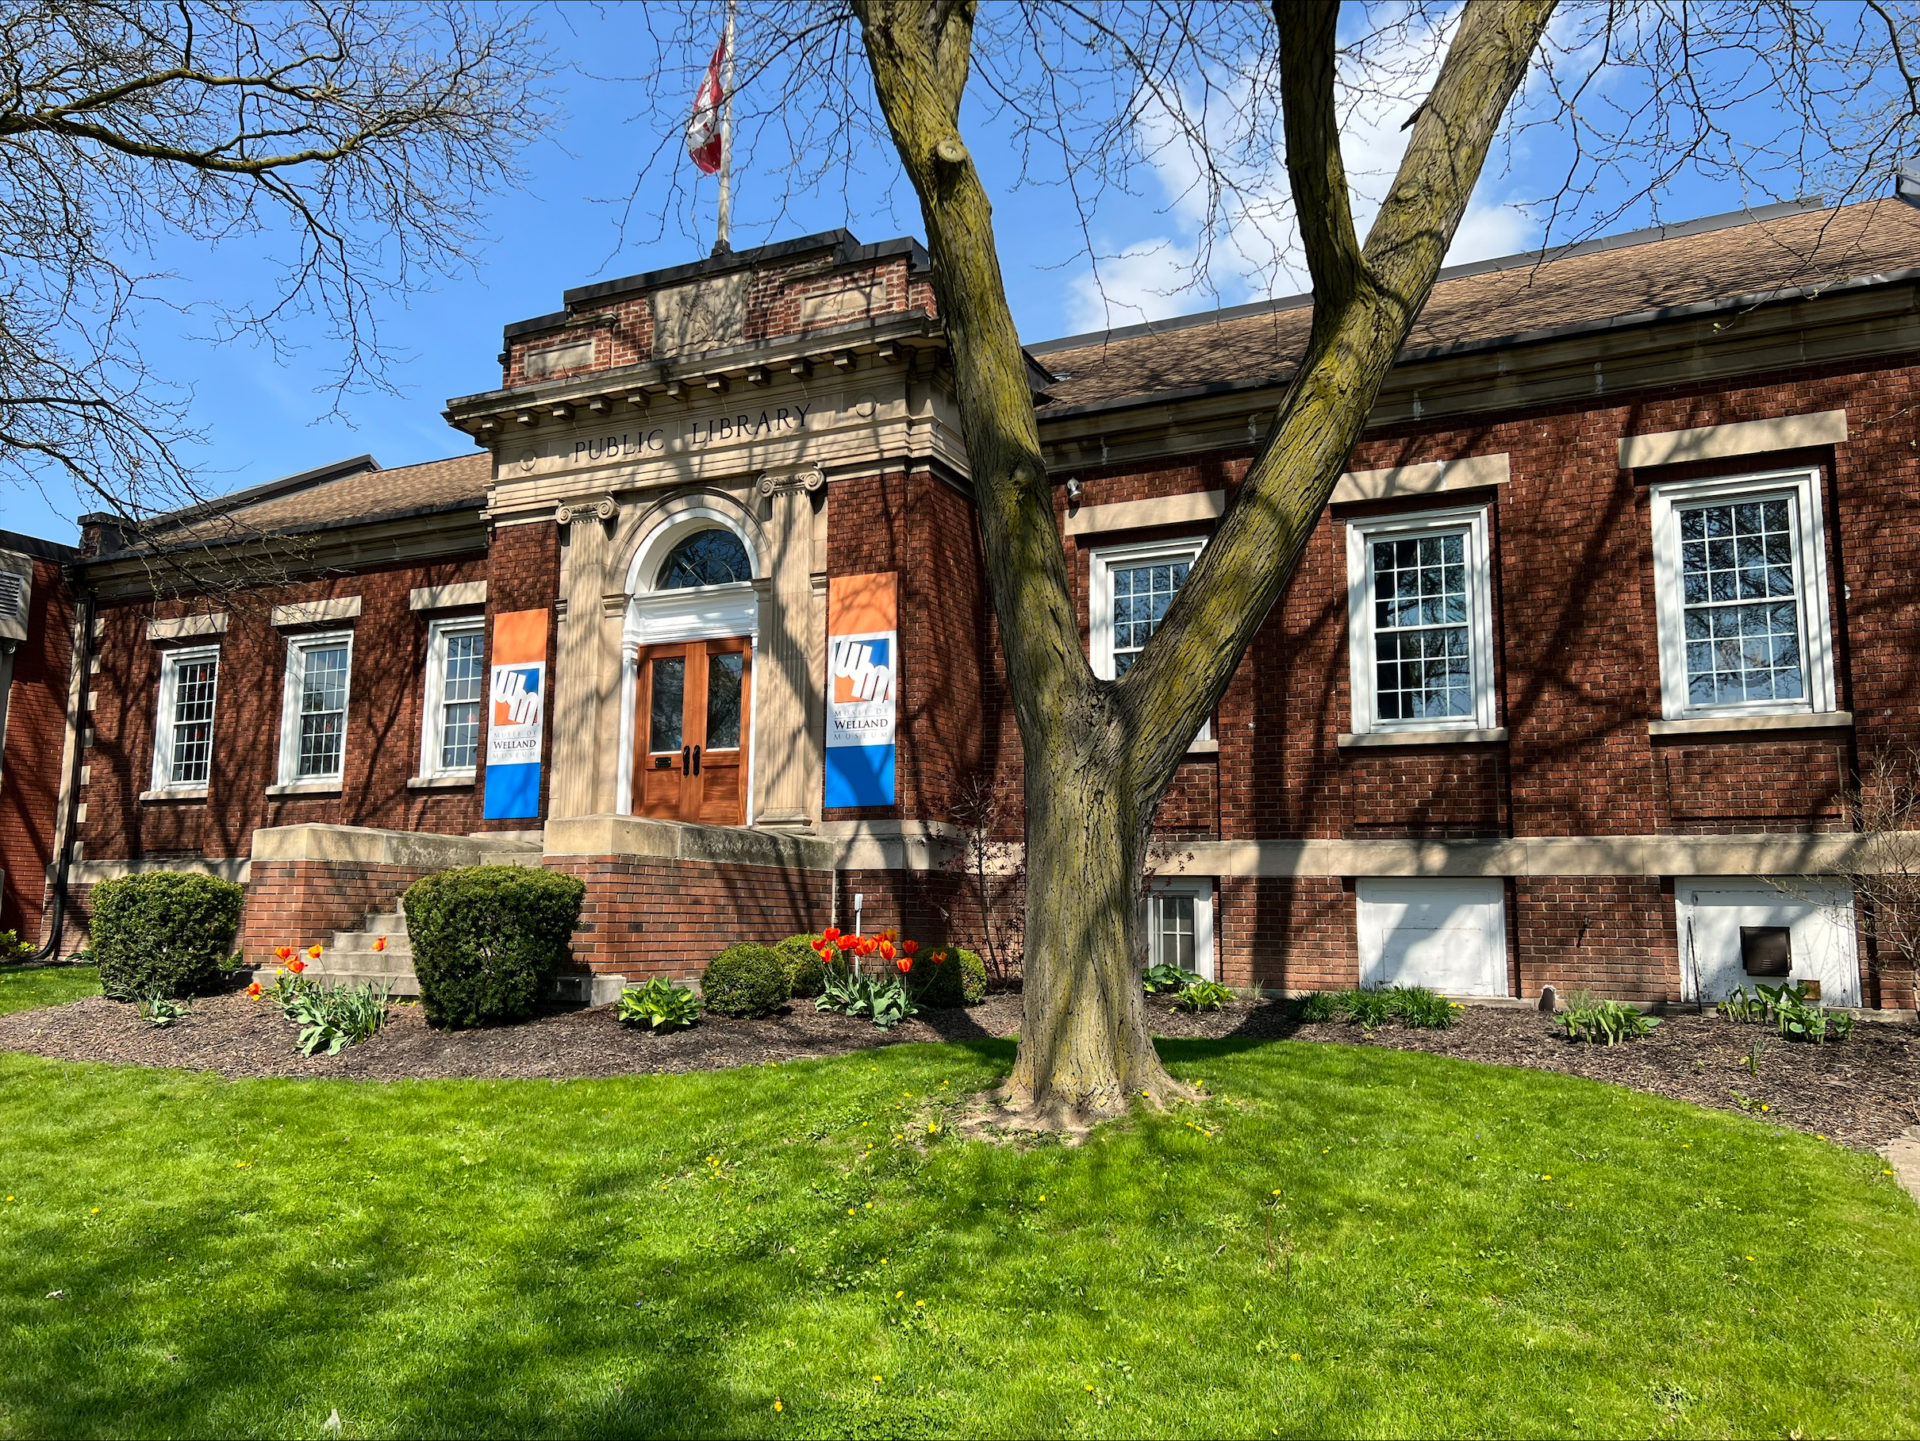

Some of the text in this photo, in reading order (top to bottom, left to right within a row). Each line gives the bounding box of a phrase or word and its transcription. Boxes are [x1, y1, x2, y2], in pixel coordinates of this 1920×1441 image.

[574, 403, 812, 463] PUBLIC LIBRARY
[834, 718, 889, 730] WELLAND
[833, 731, 888, 741] MUSEUM
[493, 739, 537, 750] WELLAND
